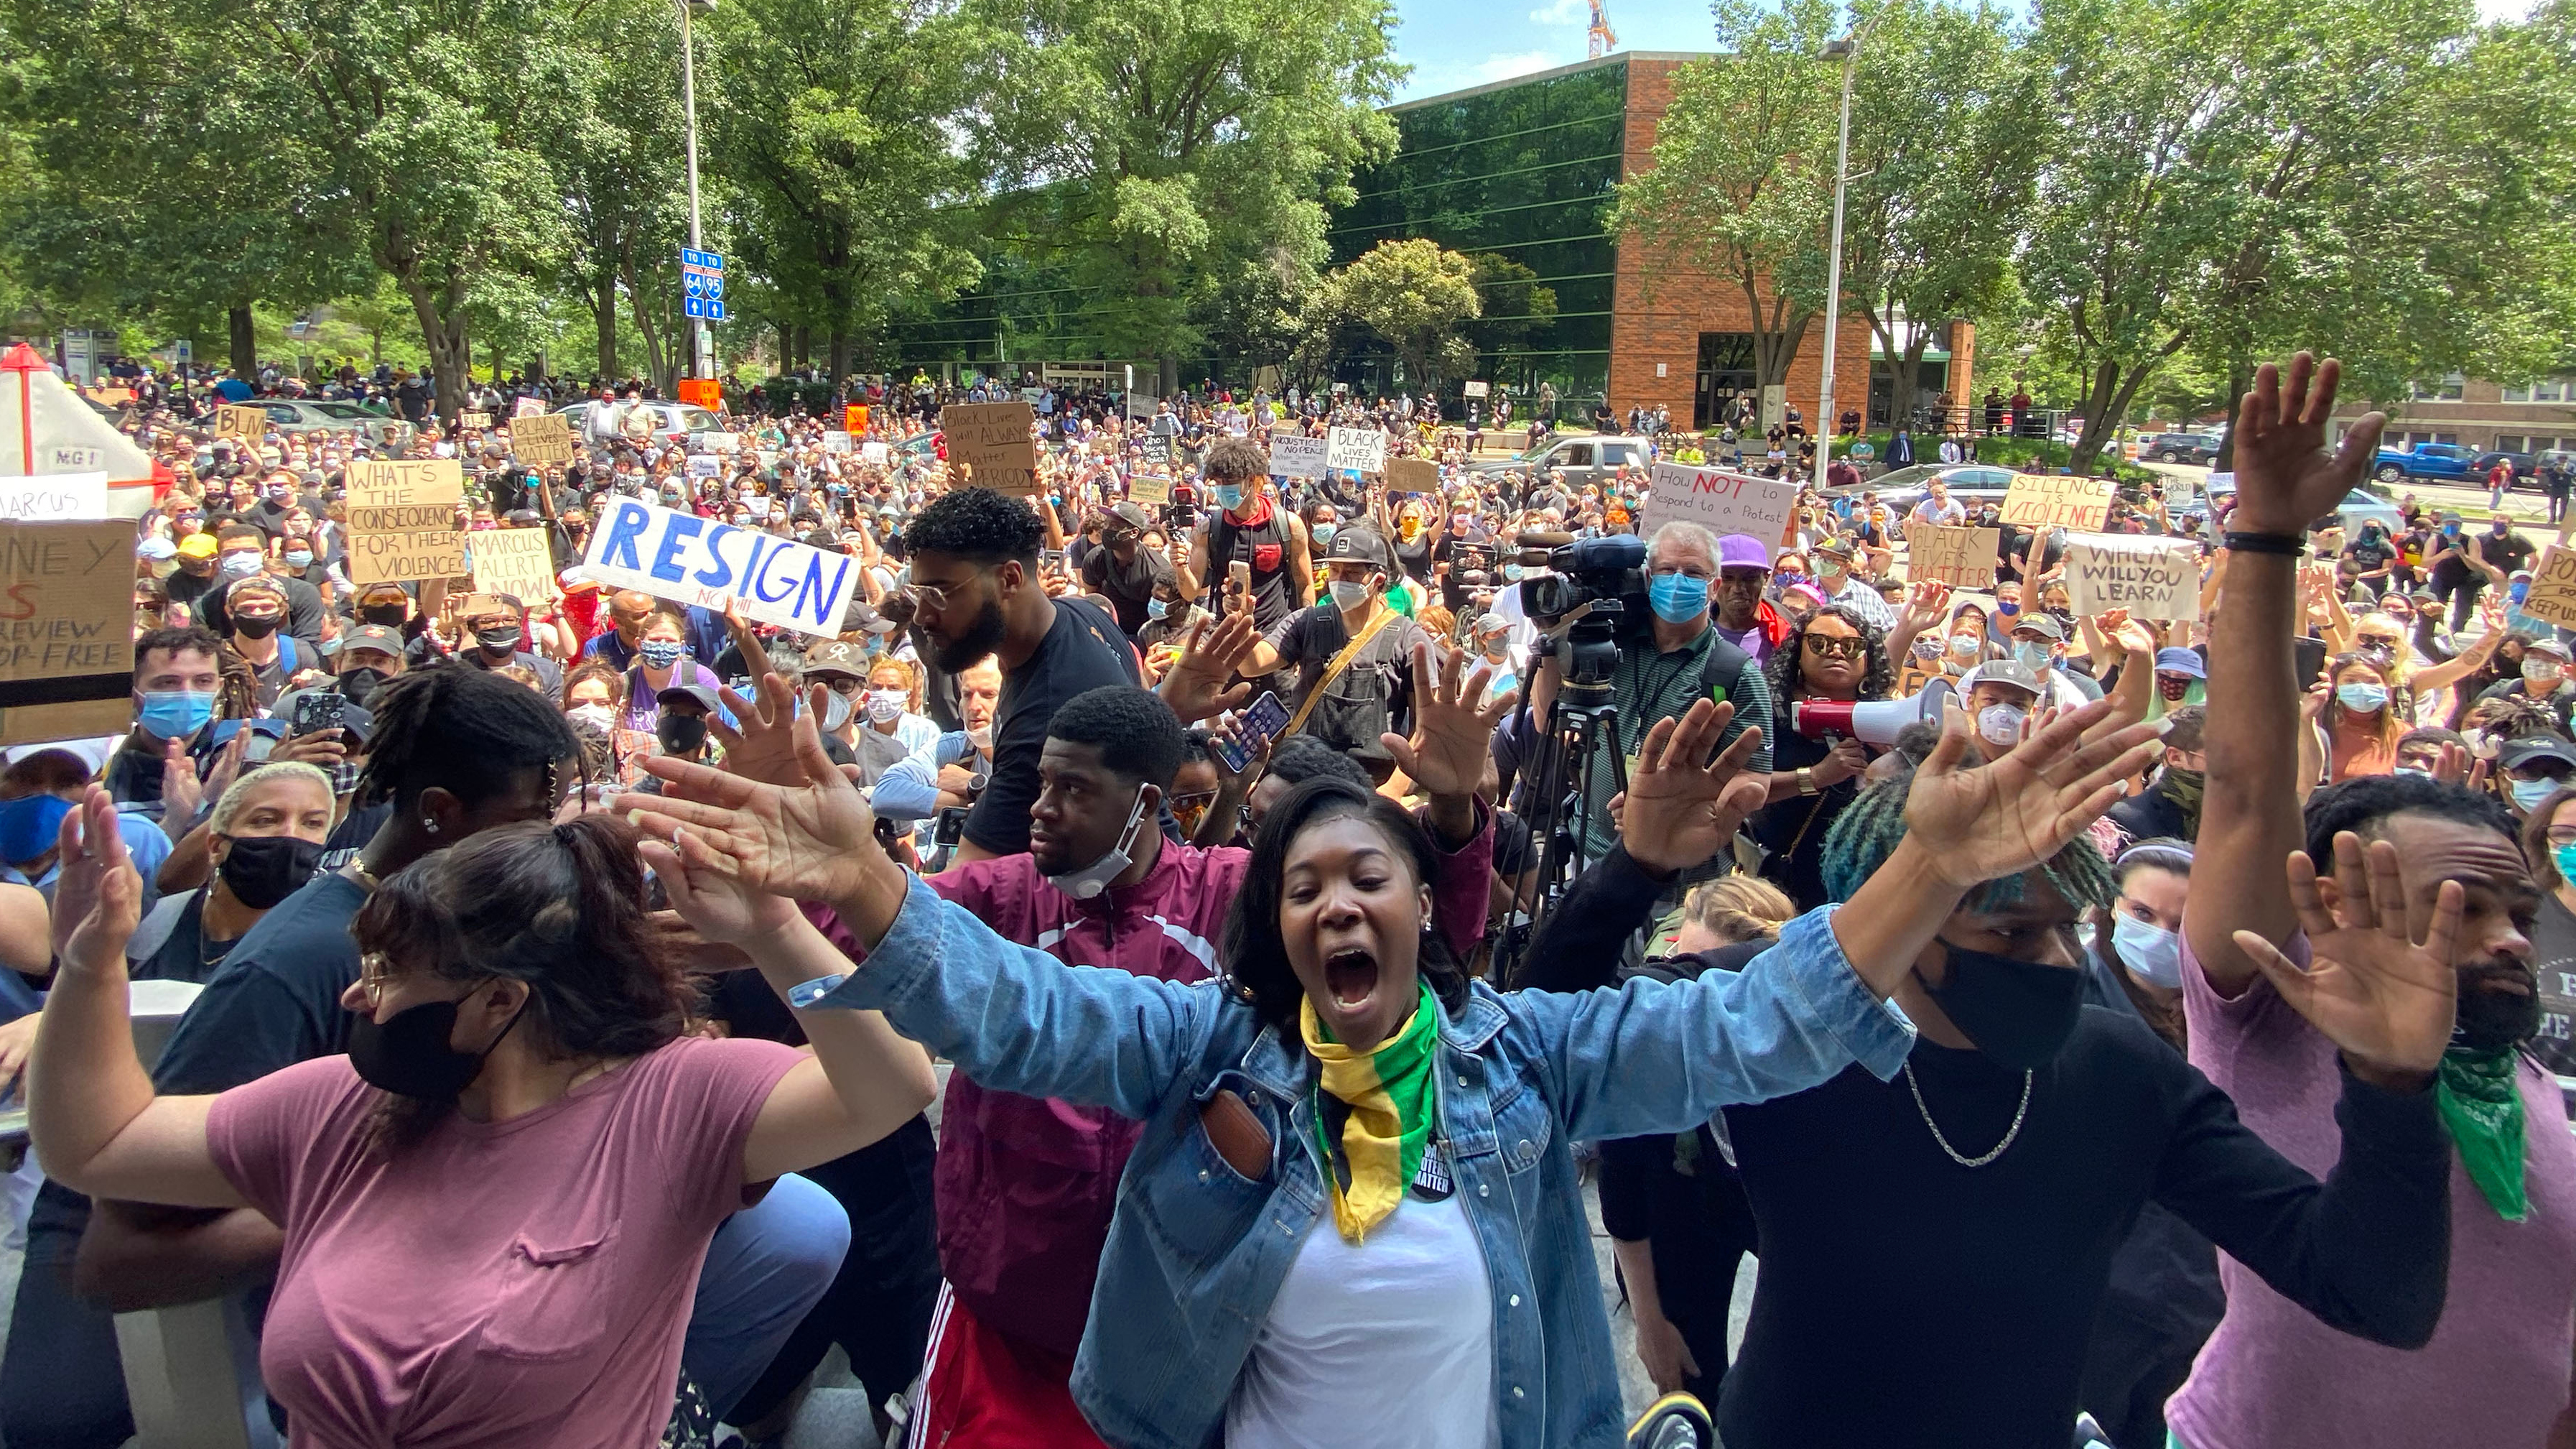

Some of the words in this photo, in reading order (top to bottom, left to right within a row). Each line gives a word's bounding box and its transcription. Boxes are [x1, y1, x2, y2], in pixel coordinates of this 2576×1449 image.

[687, 252, 698, 263] TO
[707, 256, 718, 267] TO
[687, 274, 702, 290] 64
[706, 277, 721, 293] 95
[220, 409, 265, 435] BLM
[464, 415, 490, 427] BLM
[514, 415, 567, 435] BLACK
[527, 434, 559, 445] LIVES
[1339, 430, 1381, 450] BLACK
[516, 442, 572, 463] MATTER
[1331, 453, 1377, 471] MATTER
[1343, 446, 1371, 457] LIVES
[348, 463, 437, 489] WHAT'S
[1659, 470, 1691, 488] How
[1692, 473, 1749, 499] NOT
[1762, 486, 1778, 499] to
[364, 489, 414, 505] THE
[2014, 477, 2108, 497] SILENCE
[1649, 487, 1694, 509] Respond
[1700, 500, 1714, 511] to
[1742, 506, 1783, 524] Protest
[2045, 494, 2064, 504] IS
[352, 507, 460, 530] CONSEQUENC
[2008, 500, 2108, 529] VIOLENCE
[356, 534, 400, 557] FOR
[404, 532, 460, 550] THEIR
[472, 532, 544, 556] MARCUS
[1913, 527, 1982, 550] BLACK
[0, 536, 120, 575] NEY
[374, 550, 465, 578] VIOLENCE?
[600, 503, 850, 626] RESIGN
[1912, 550, 1968, 570] LIVES
[2088, 543, 2171, 565] WHEN
[481, 555, 539, 578] ALERT
[1911, 565, 1989, 588] MATTER
[2083, 565, 2136, 581] WILL
[2139, 567, 2182, 586] YOU
[2096, 583, 2174, 602] LEARN
[2523, 597, 2560, 616] KEEP
[1420, 1156, 1450, 1179] OTERS
